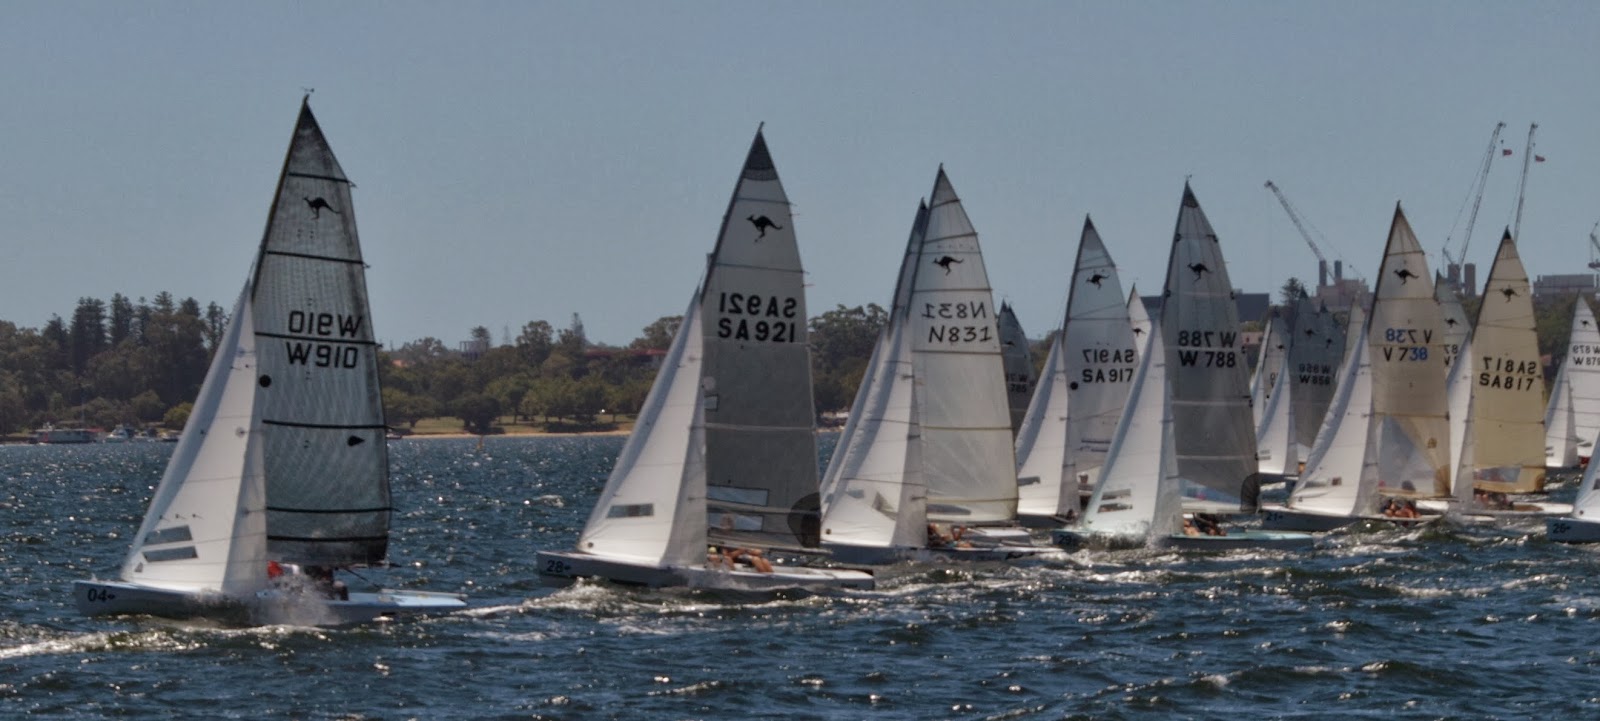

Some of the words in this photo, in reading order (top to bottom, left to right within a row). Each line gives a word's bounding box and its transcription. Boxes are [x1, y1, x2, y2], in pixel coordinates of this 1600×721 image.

[928, 325, 992, 343] N831
[1205, 351, 1236, 368] 788
[1399, 346, 1428, 361] 738
